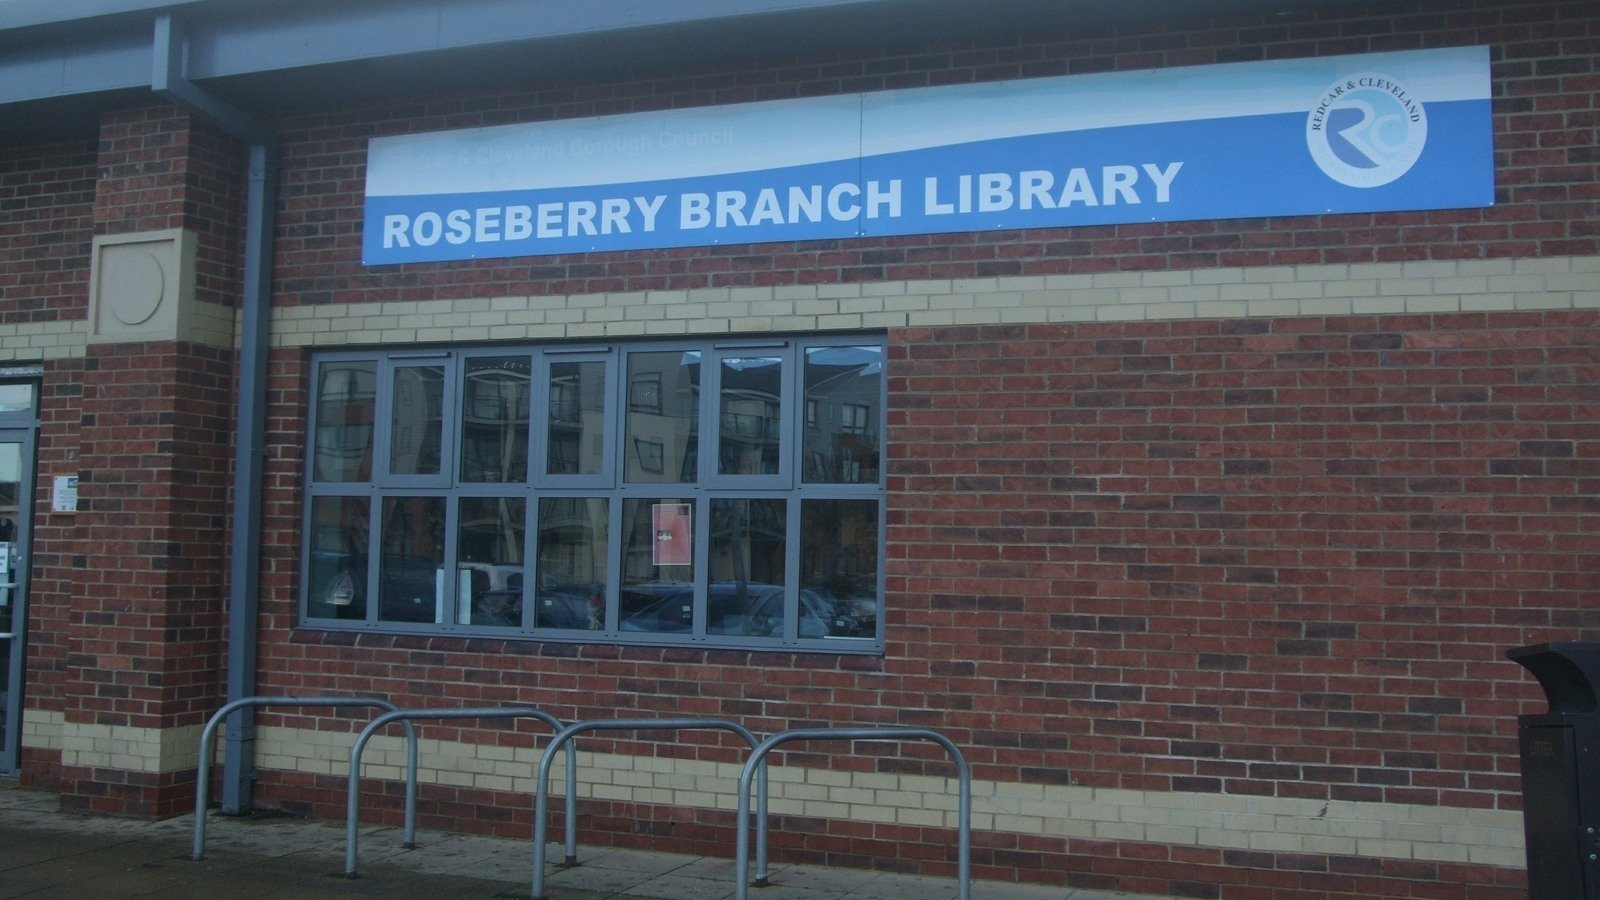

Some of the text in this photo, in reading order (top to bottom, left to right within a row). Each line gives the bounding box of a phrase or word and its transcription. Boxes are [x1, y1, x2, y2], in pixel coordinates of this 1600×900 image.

[1312, 77, 1421, 131] REDCAR & CLEVELAND
[383, 162, 1184, 249] ROSEBERRY BRANCH LIBRARY
